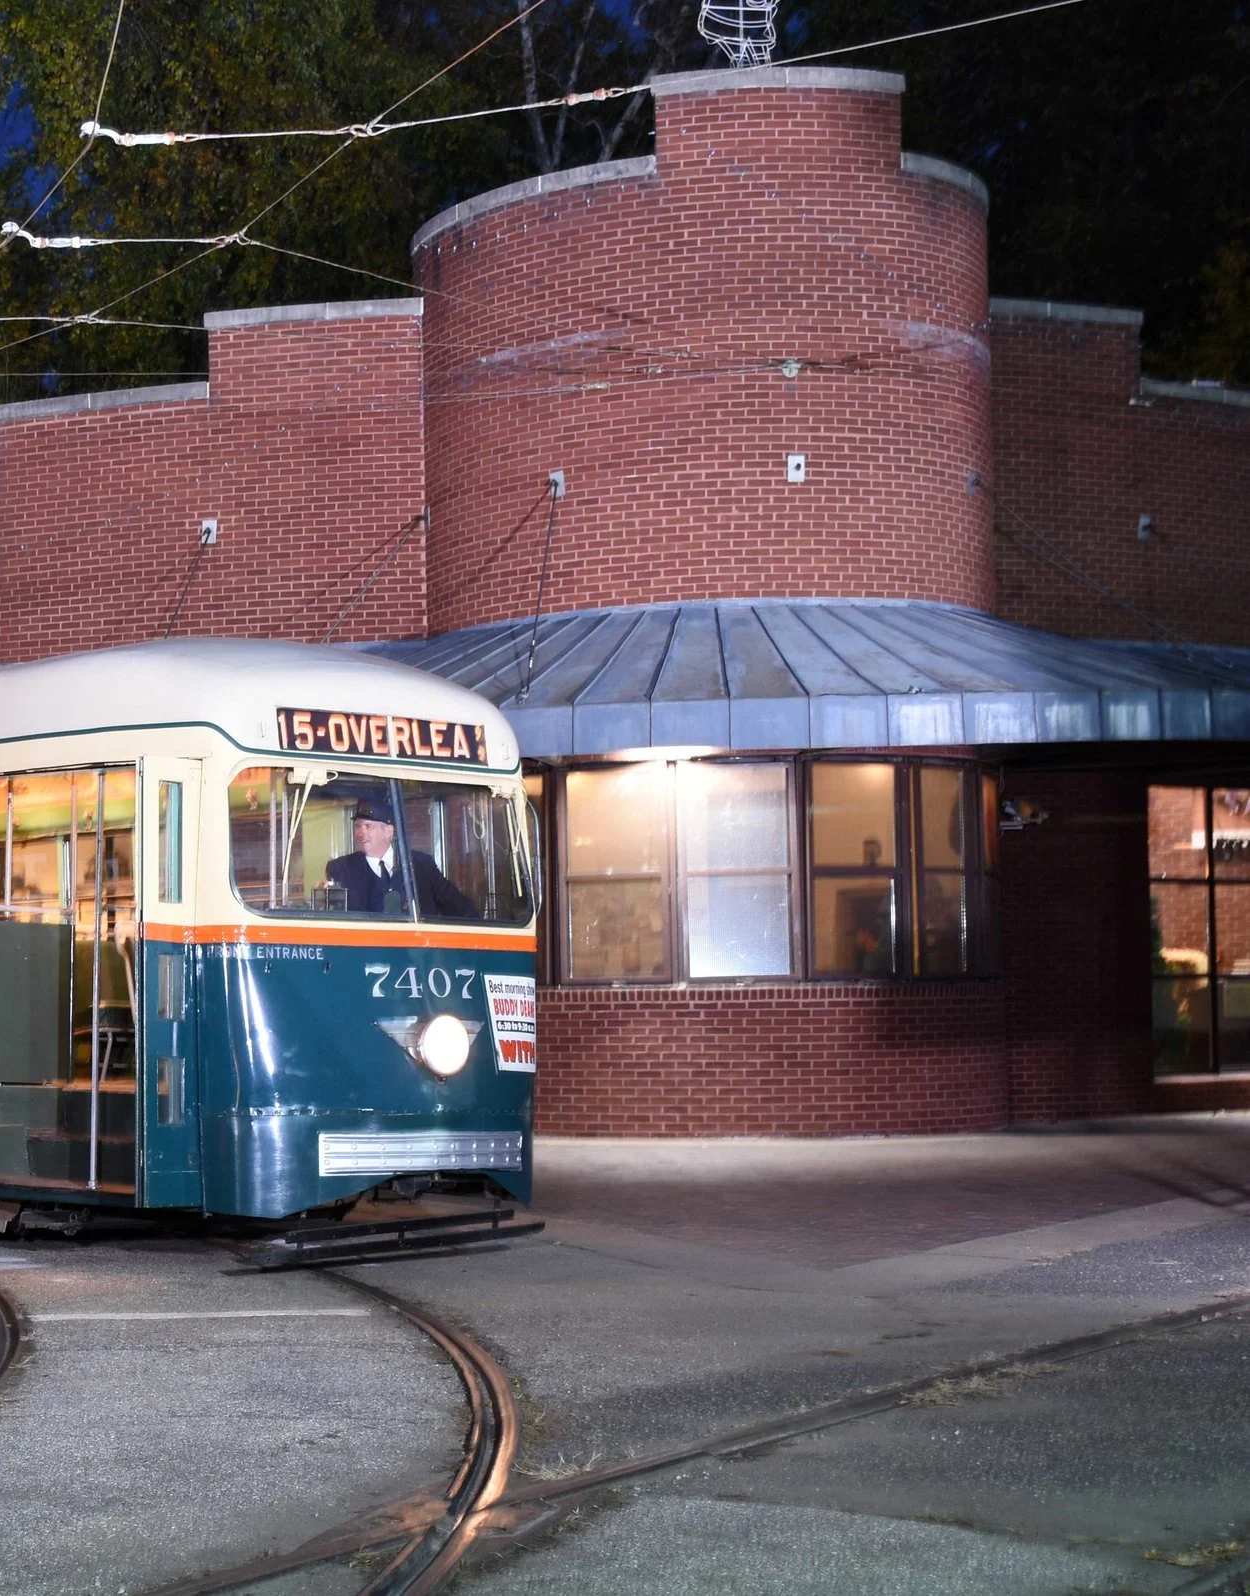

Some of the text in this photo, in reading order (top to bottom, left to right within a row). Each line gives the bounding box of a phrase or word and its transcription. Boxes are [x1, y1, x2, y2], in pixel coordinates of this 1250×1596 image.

[278, 712, 470, 758] 15-OVERLEA
[256, 946, 324, 960] ENTRANCE
[364, 965, 476, 999] 7407
[488, 980, 504, 994] Best
[504, 982, 526, 998] morning
[493, 998, 519, 1016] BUDDY
[497, 1021, 511, 1031] 6:30
